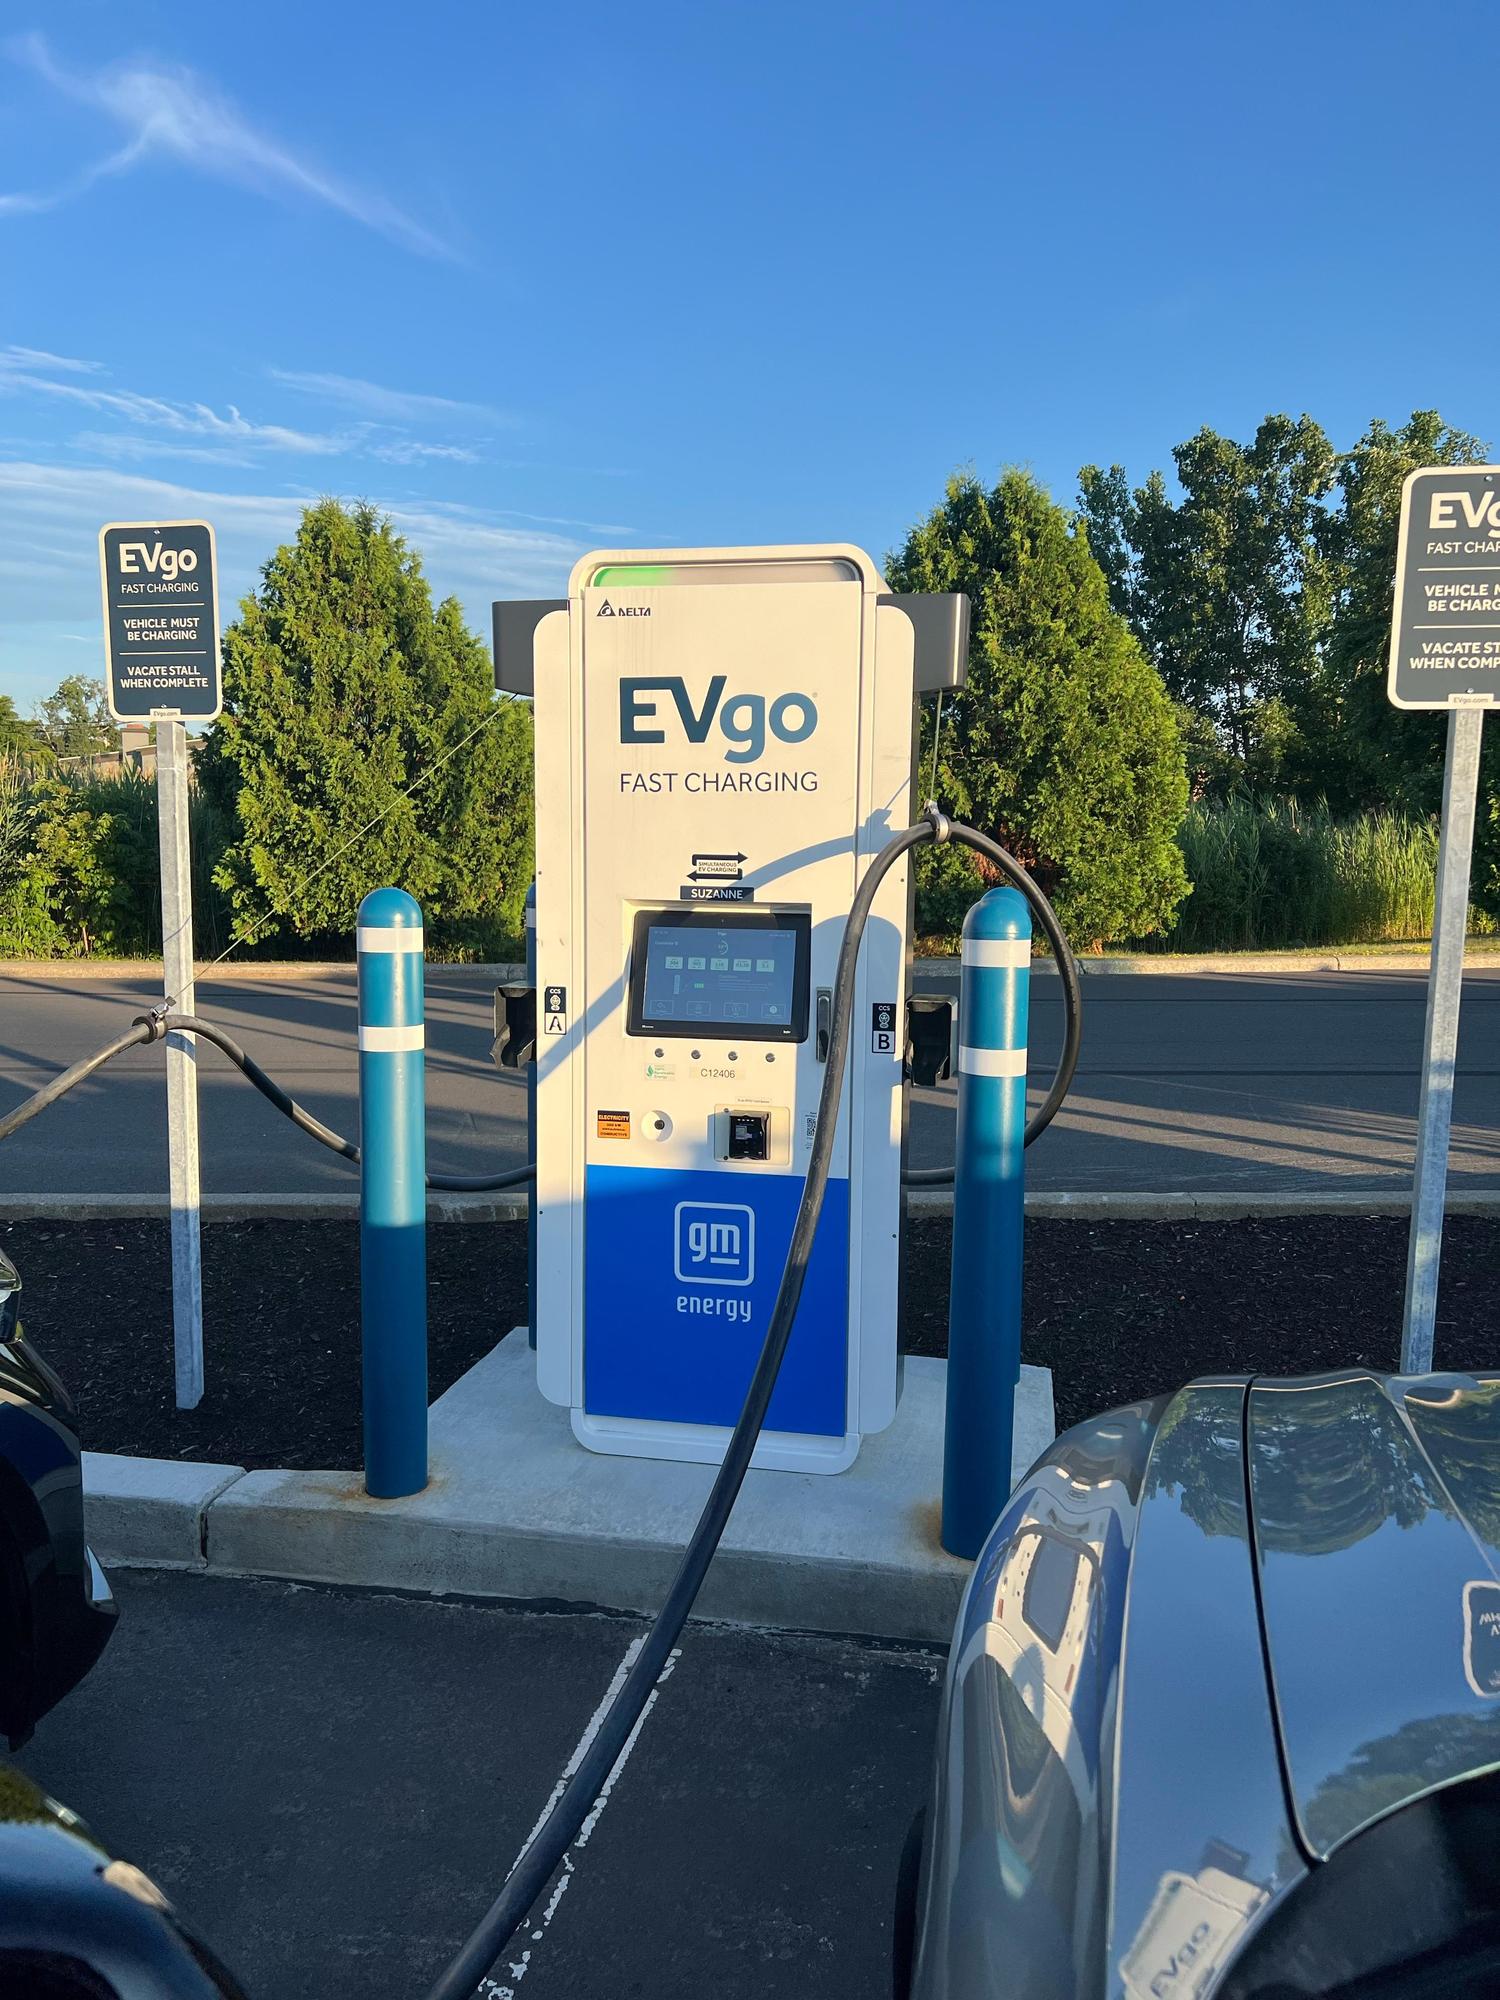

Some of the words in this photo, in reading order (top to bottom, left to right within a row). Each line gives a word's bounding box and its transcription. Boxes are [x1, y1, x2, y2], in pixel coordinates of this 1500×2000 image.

[1426, 542, 1462, 554] FAST
[119, 543, 198, 580] EVgo
[121, 584, 145, 593] FAST
[147, 582, 199, 593] CHARGING
[1424, 584, 1489, 597] VEHICLE
[618, 607, 651, 616] DELTA
[1427, 600, 1447, 611] BE
[124, 619, 167, 629] VEHICLE
[170, 618, 199, 628] MUST
[127, 631, 141, 641] BE
[142, 630, 197, 640] CHARGING
[1422, 642, 1481, 654] VACATE
[1409, 657, 1455, 669] WHEN
[127, 666, 167, 676] VACATE
[169, 666, 200, 675] STALL
[120, 679, 151, 688] WHEN
[153, 678, 208, 688] COMPLETE
[620, 675, 818, 764] EVgo
[620, 773, 678, 792] FAST
[684, 771, 818, 792] CHARGING
[691, 889, 743, 899] SUZANNE
[549, 1016, 562, 1031] A
[878, 1034, 890, 1049] B
[700, 1068, 736, 1079] C12406
[688, 1222, 740, 1264] gm
[676, 1296, 751, 1322] energy
